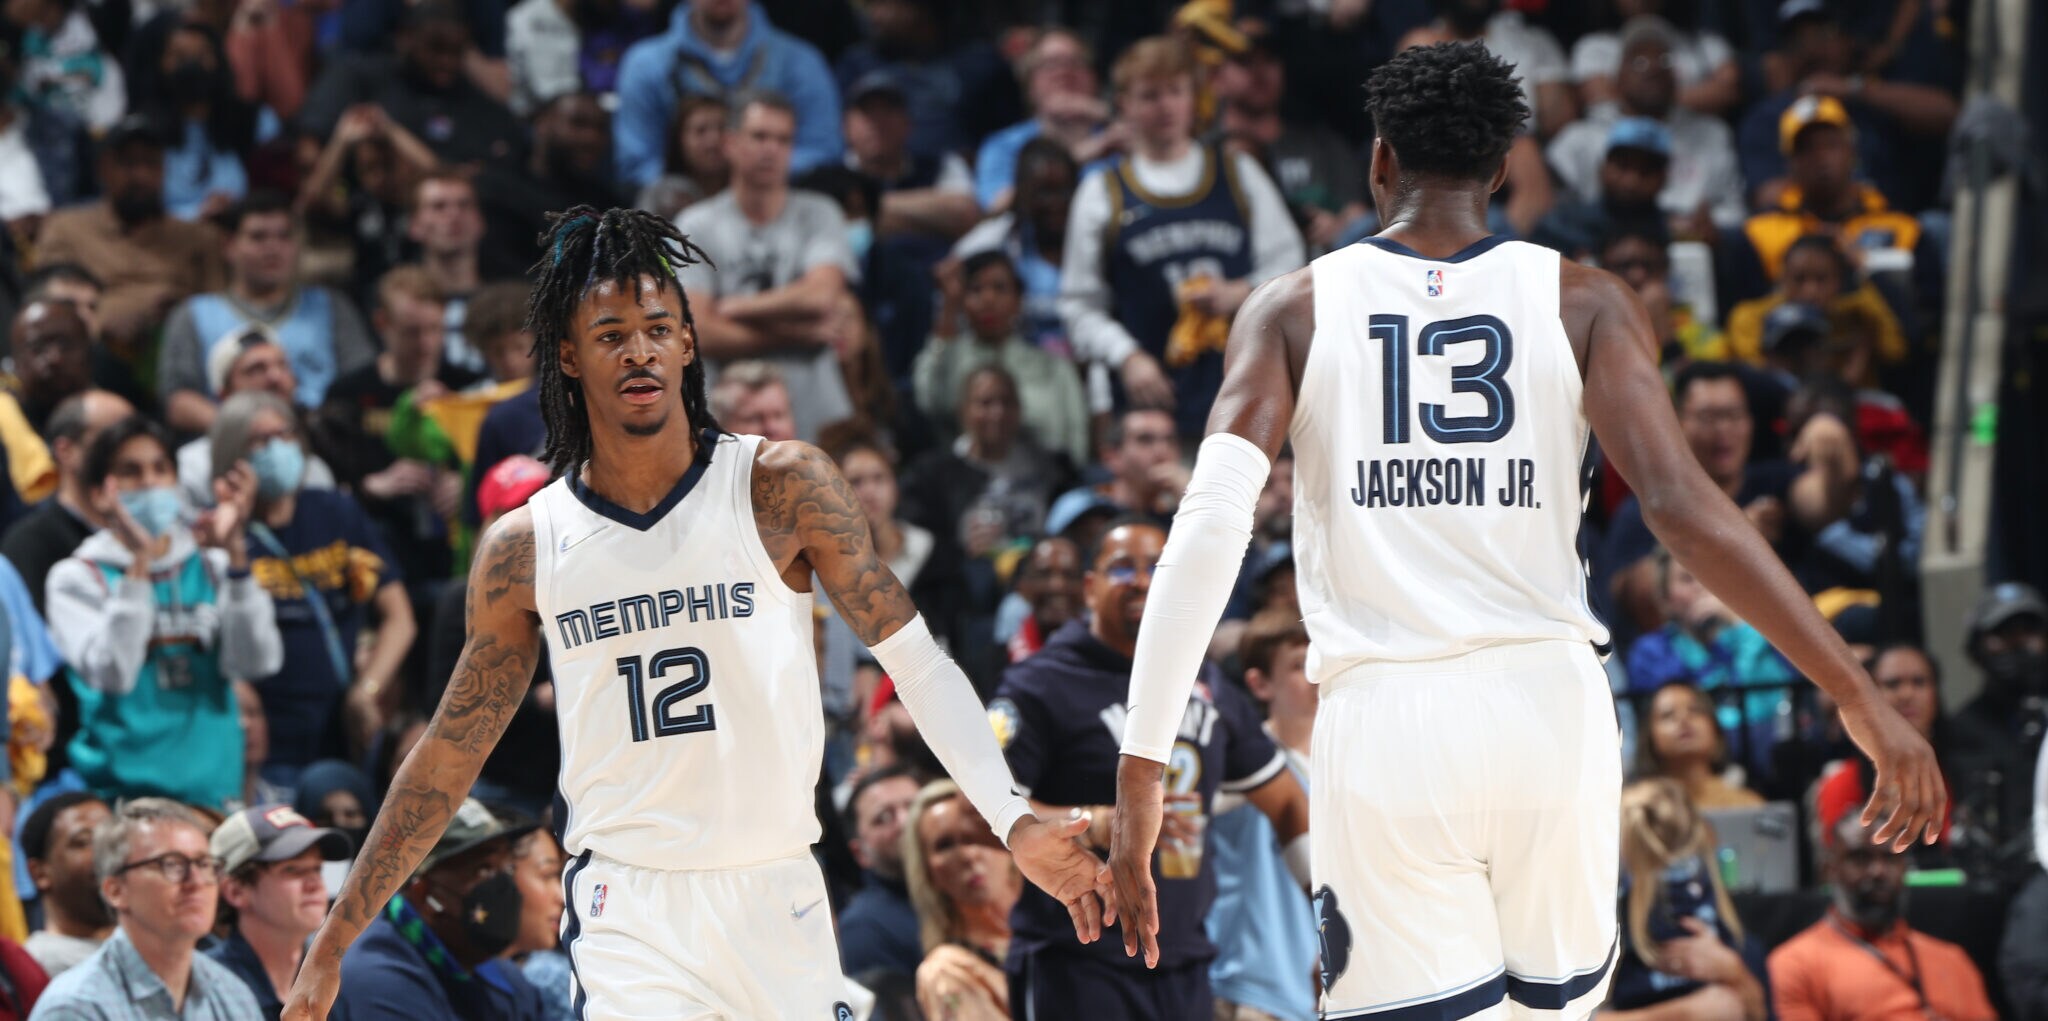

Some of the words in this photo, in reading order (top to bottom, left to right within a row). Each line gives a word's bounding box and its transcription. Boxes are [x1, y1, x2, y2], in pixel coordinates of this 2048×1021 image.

[1369, 314, 1515, 444] 13
[1351, 458, 1485, 508] JACKSON
[1498, 458, 1541, 509] JR.
[555, 582, 755, 650] MEMPHIS
[616, 646, 717, 742] 12
